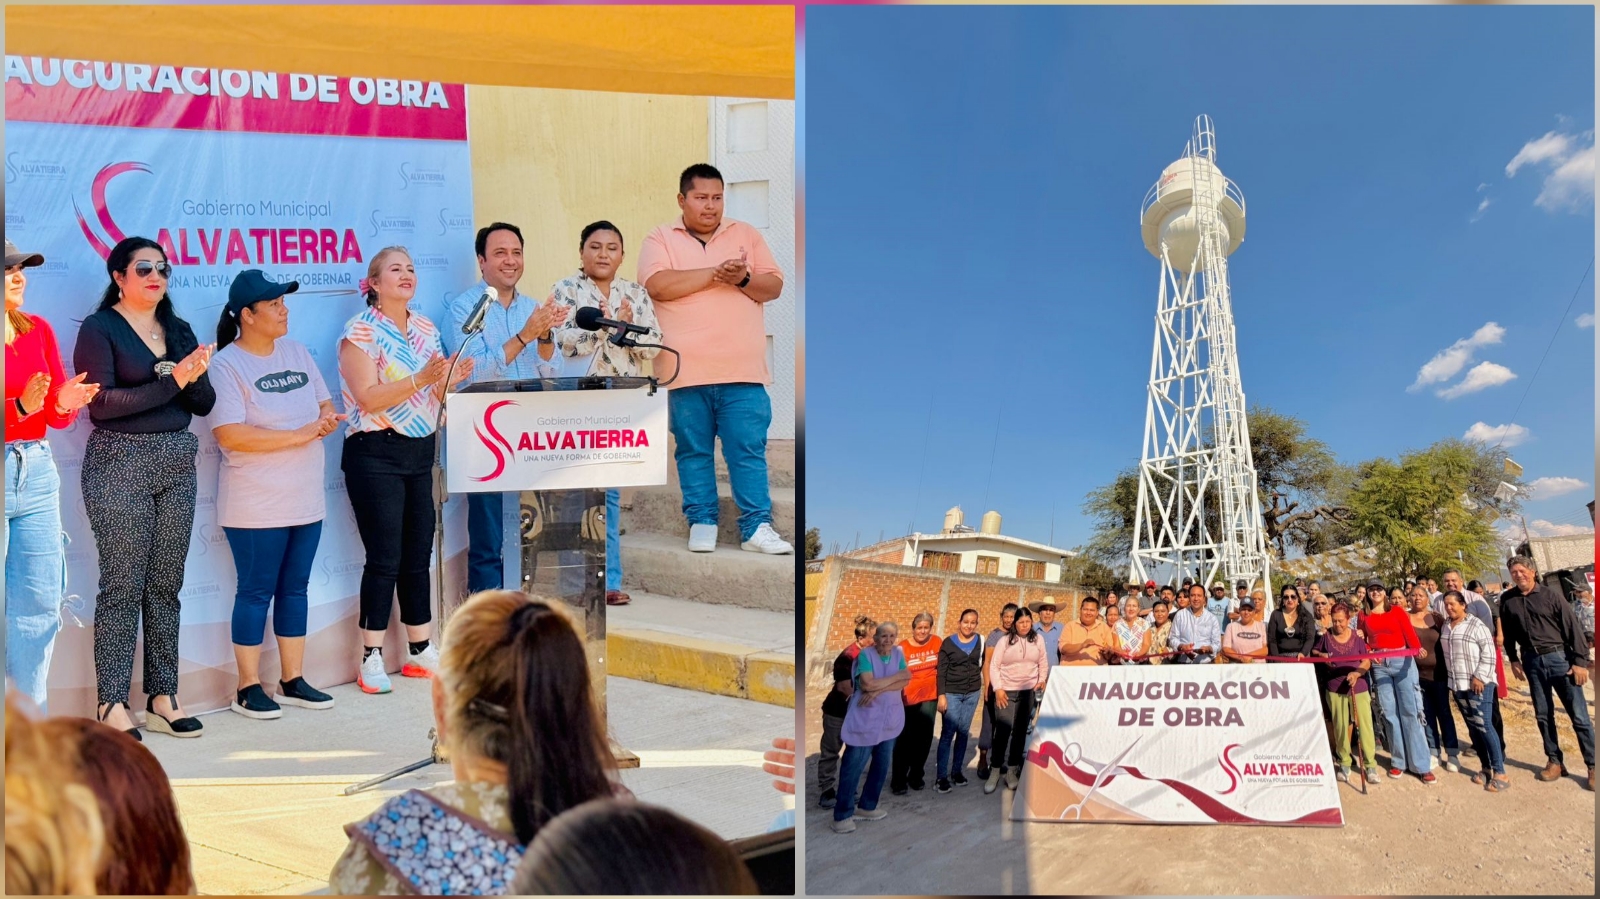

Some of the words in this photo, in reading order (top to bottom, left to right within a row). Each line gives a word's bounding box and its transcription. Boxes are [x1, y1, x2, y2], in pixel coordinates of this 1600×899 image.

[289, 72, 340, 103] DE
[349, 76, 449, 109] OBRA
[182, 199, 256, 217] Gobierno
[260, 200, 331, 220] Municipal
[193, 274, 231, 288] NUEVA
[298, 272, 352, 286] GOBERNAR
[536, 416, 582, 426] Gobierno
[584, 414, 631, 426] Municipal
[523, 454, 539, 462] UNA
[540, 453, 564, 462] NUEVA
[565, 452, 591, 461] FORMA
[592, 452, 602, 460] DE
[602, 451, 641, 460] GOBERNAR
[1078, 676, 1291, 701] INAUGURACIÓN
[1117, 707, 1156, 727] DE
[1162, 706, 1245, 727] OBRA
